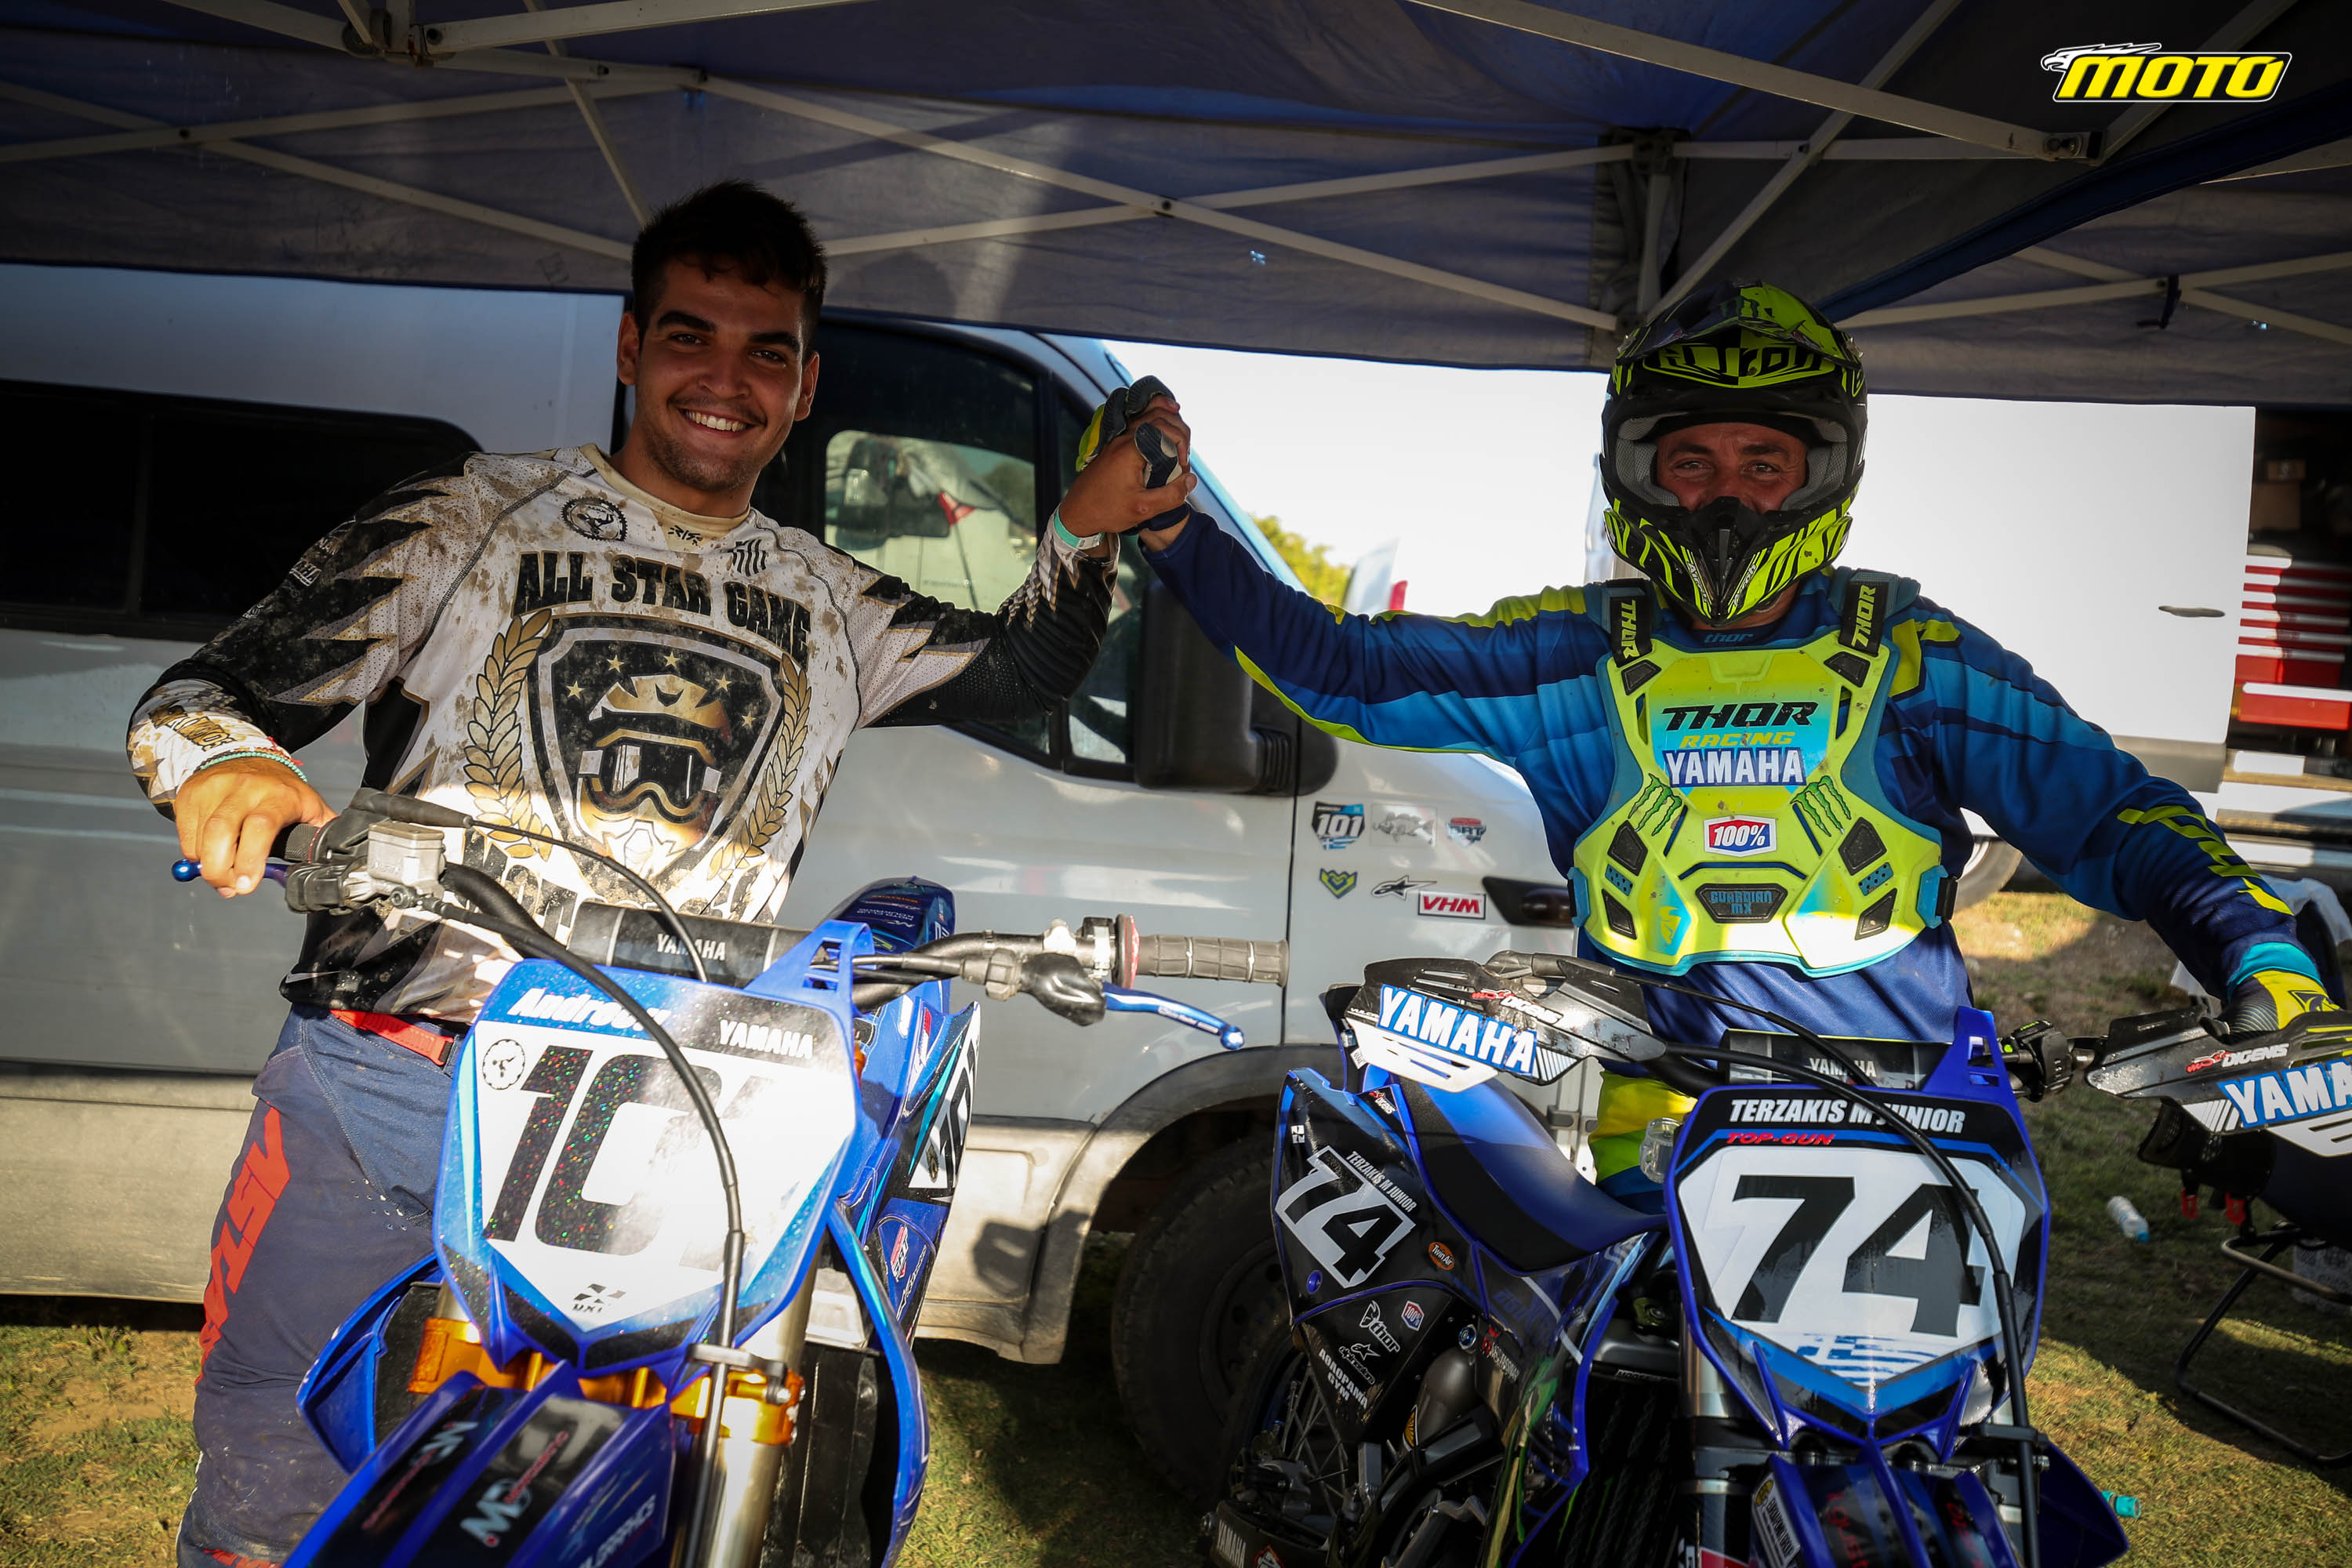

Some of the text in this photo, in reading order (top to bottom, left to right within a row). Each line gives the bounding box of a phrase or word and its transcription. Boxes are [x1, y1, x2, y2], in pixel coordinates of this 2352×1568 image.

[510, 550, 594, 619] ALL
[610, 554, 713, 617] STAR
[1618, 600, 1640, 659] THOR
[1852, 584, 1877, 648] THOR
[1704, 630, 1755, 644] thor
[1661, 701, 1819, 732] THOR
[1679, 731, 1795, 749] RACING
[1664, 749, 1804, 785] YAMAHA
[1316, 813, 1363, 838] 101
[1713, 824, 1768, 848] 100%
[1423, 895, 1481, 914] VHM
[1710, 889, 1773, 904] GUARDIAN
[1730, 903, 1752, 916] MX
[719, 1018, 814, 1060] YAMAHA
[1377, 985, 1536, 1073] YAMAHA
[1809, 1058, 1877, 1077] YAMHA
[1730, 1098, 1848, 1123] TERZAKIS
[1726, 1132, 1836, 1146] TOP-GUN
[1345, 1151, 1385, 1185] TERZAKIS
[1385, 1184, 1417, 1213] JUNIOR
[1276, 1146, 1414, 1287] 74
[1732, 1174, 1986, 1338] 74
[1403, 1305, 1422, 1327] 100%
[1369, 1319, 1401, 1353] thor
[1327, 1371, 1351, 1402] GYM
